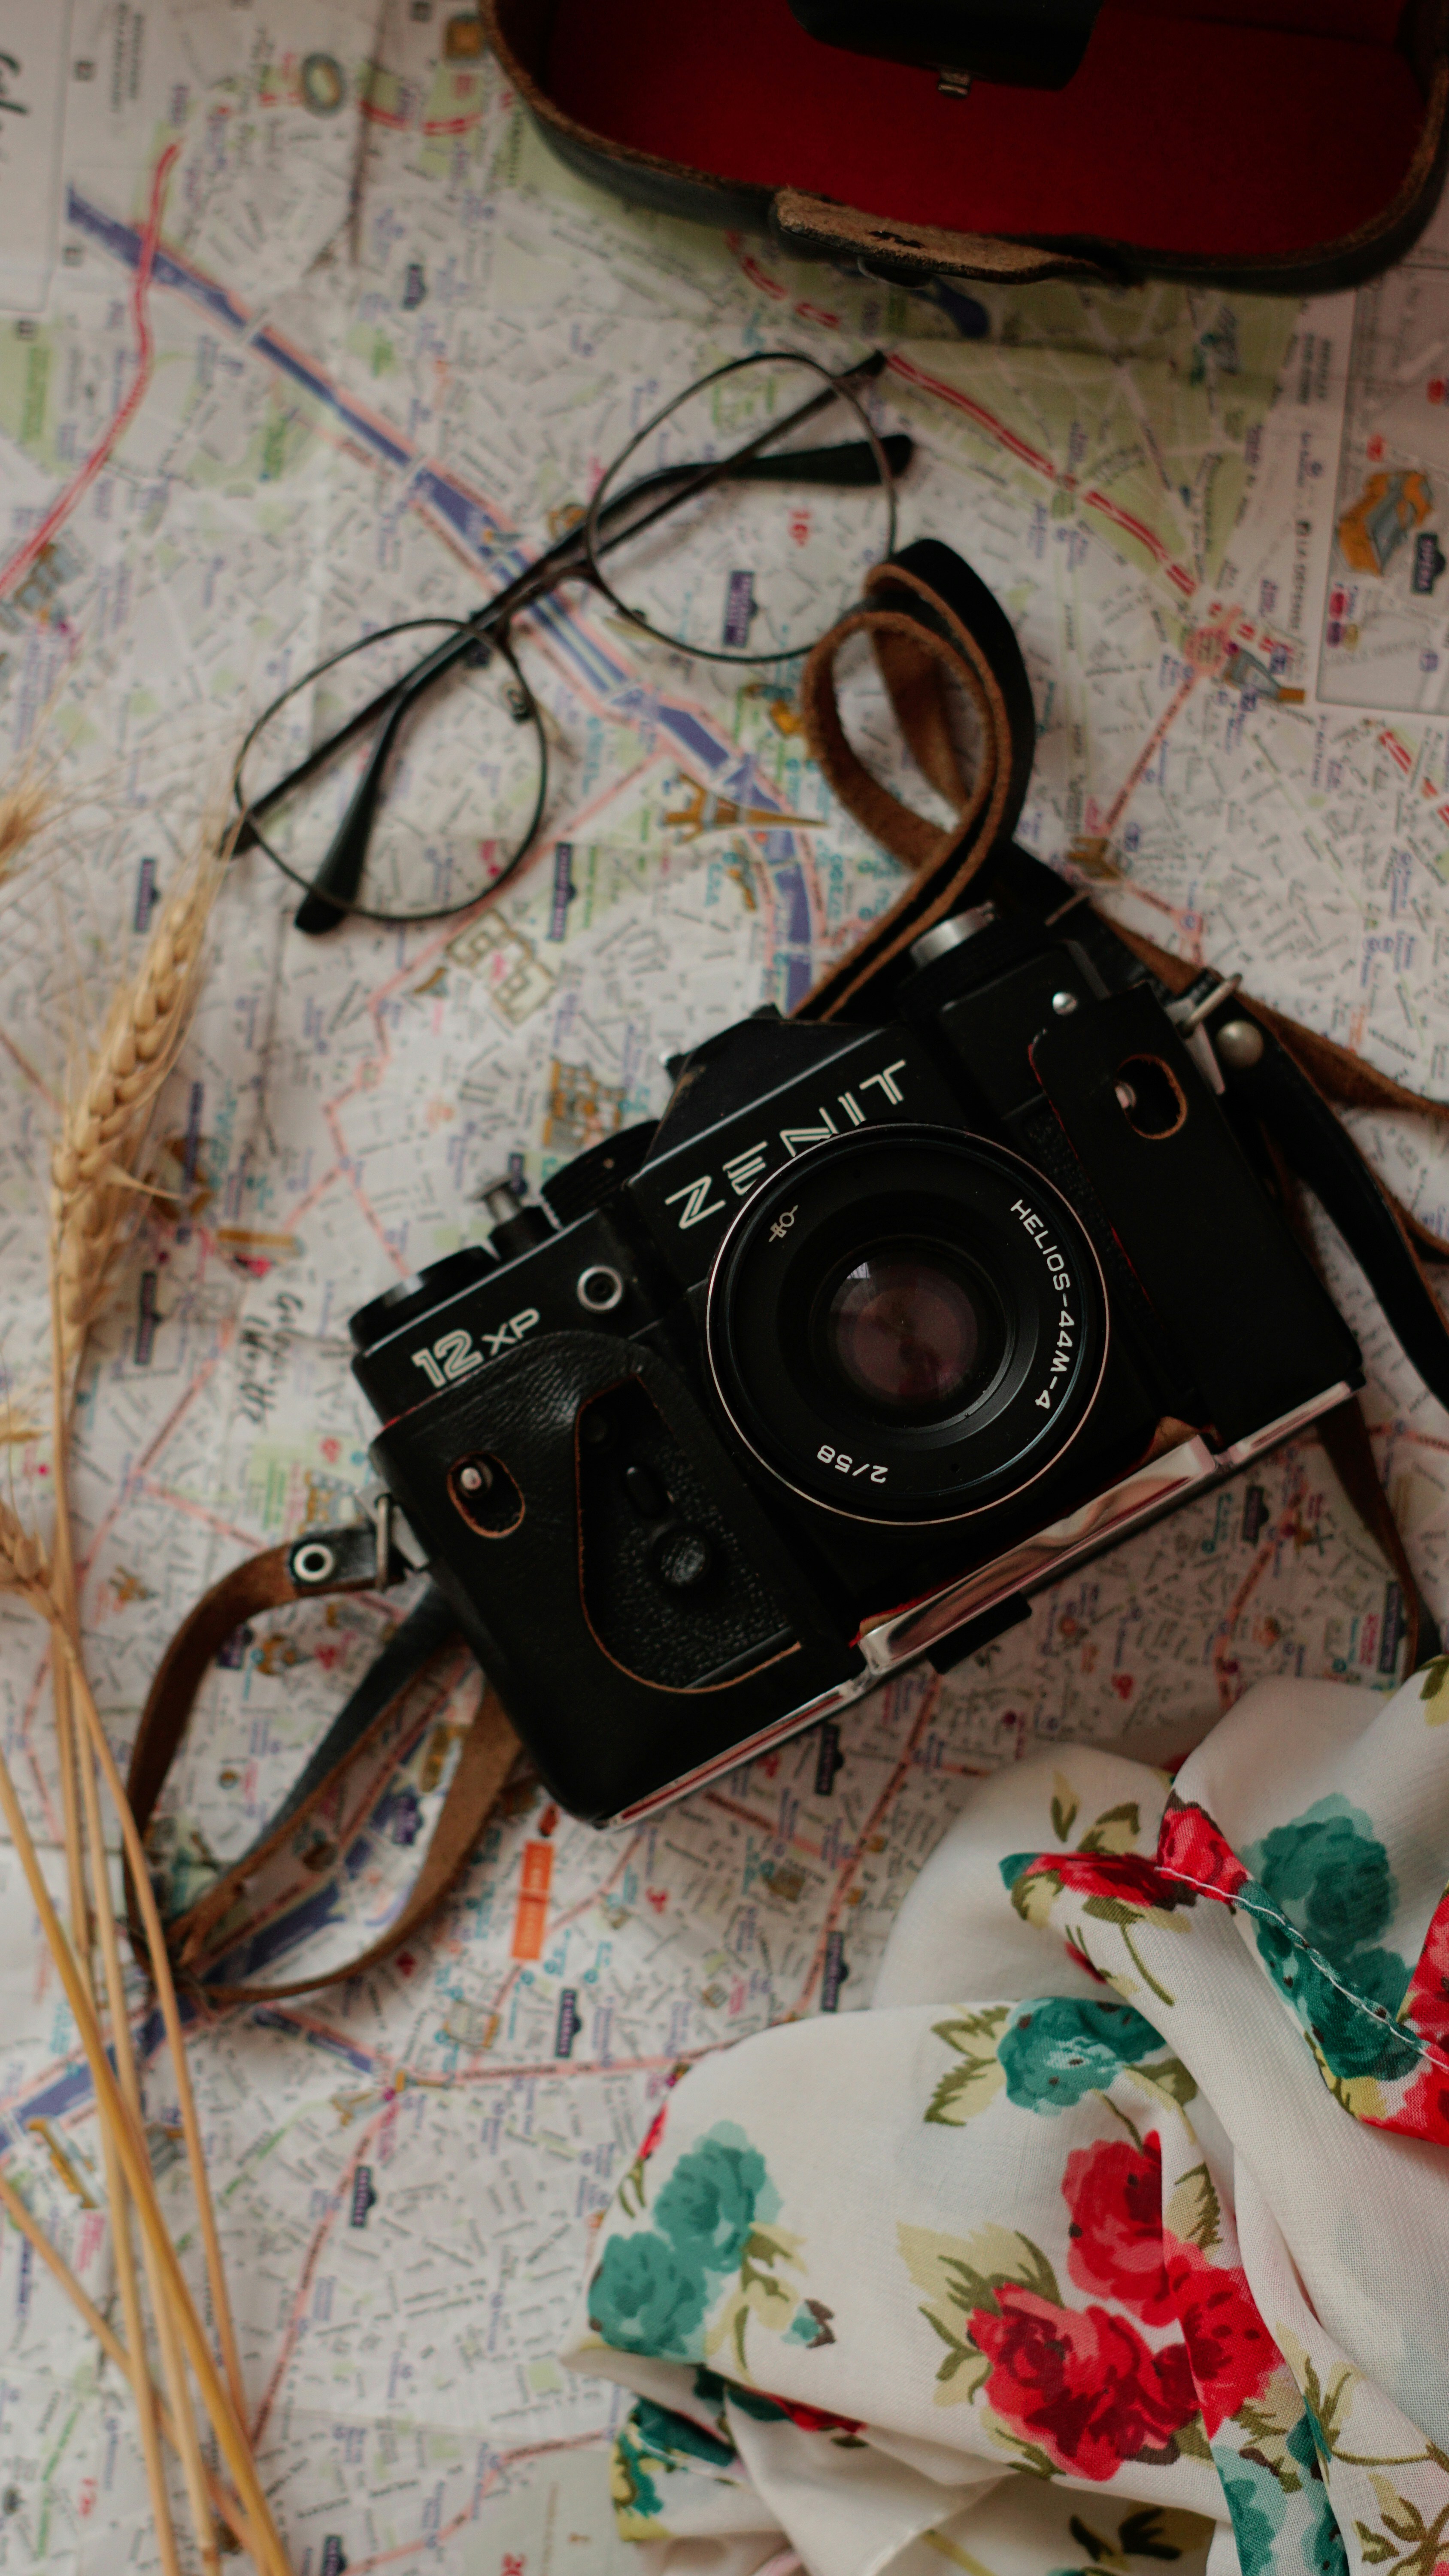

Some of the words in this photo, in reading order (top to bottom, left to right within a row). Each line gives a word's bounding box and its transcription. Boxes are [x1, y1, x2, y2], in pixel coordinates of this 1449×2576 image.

[665, 1059, 906, 1230] ZENIT
[412, 1330, 484, 1388] 12
[481, 1309, 540, 1355] XP
[1010, 1199, 1075, 1409] HELIOS-44M-4
[817, 1445, 888, 1483] 2/58
